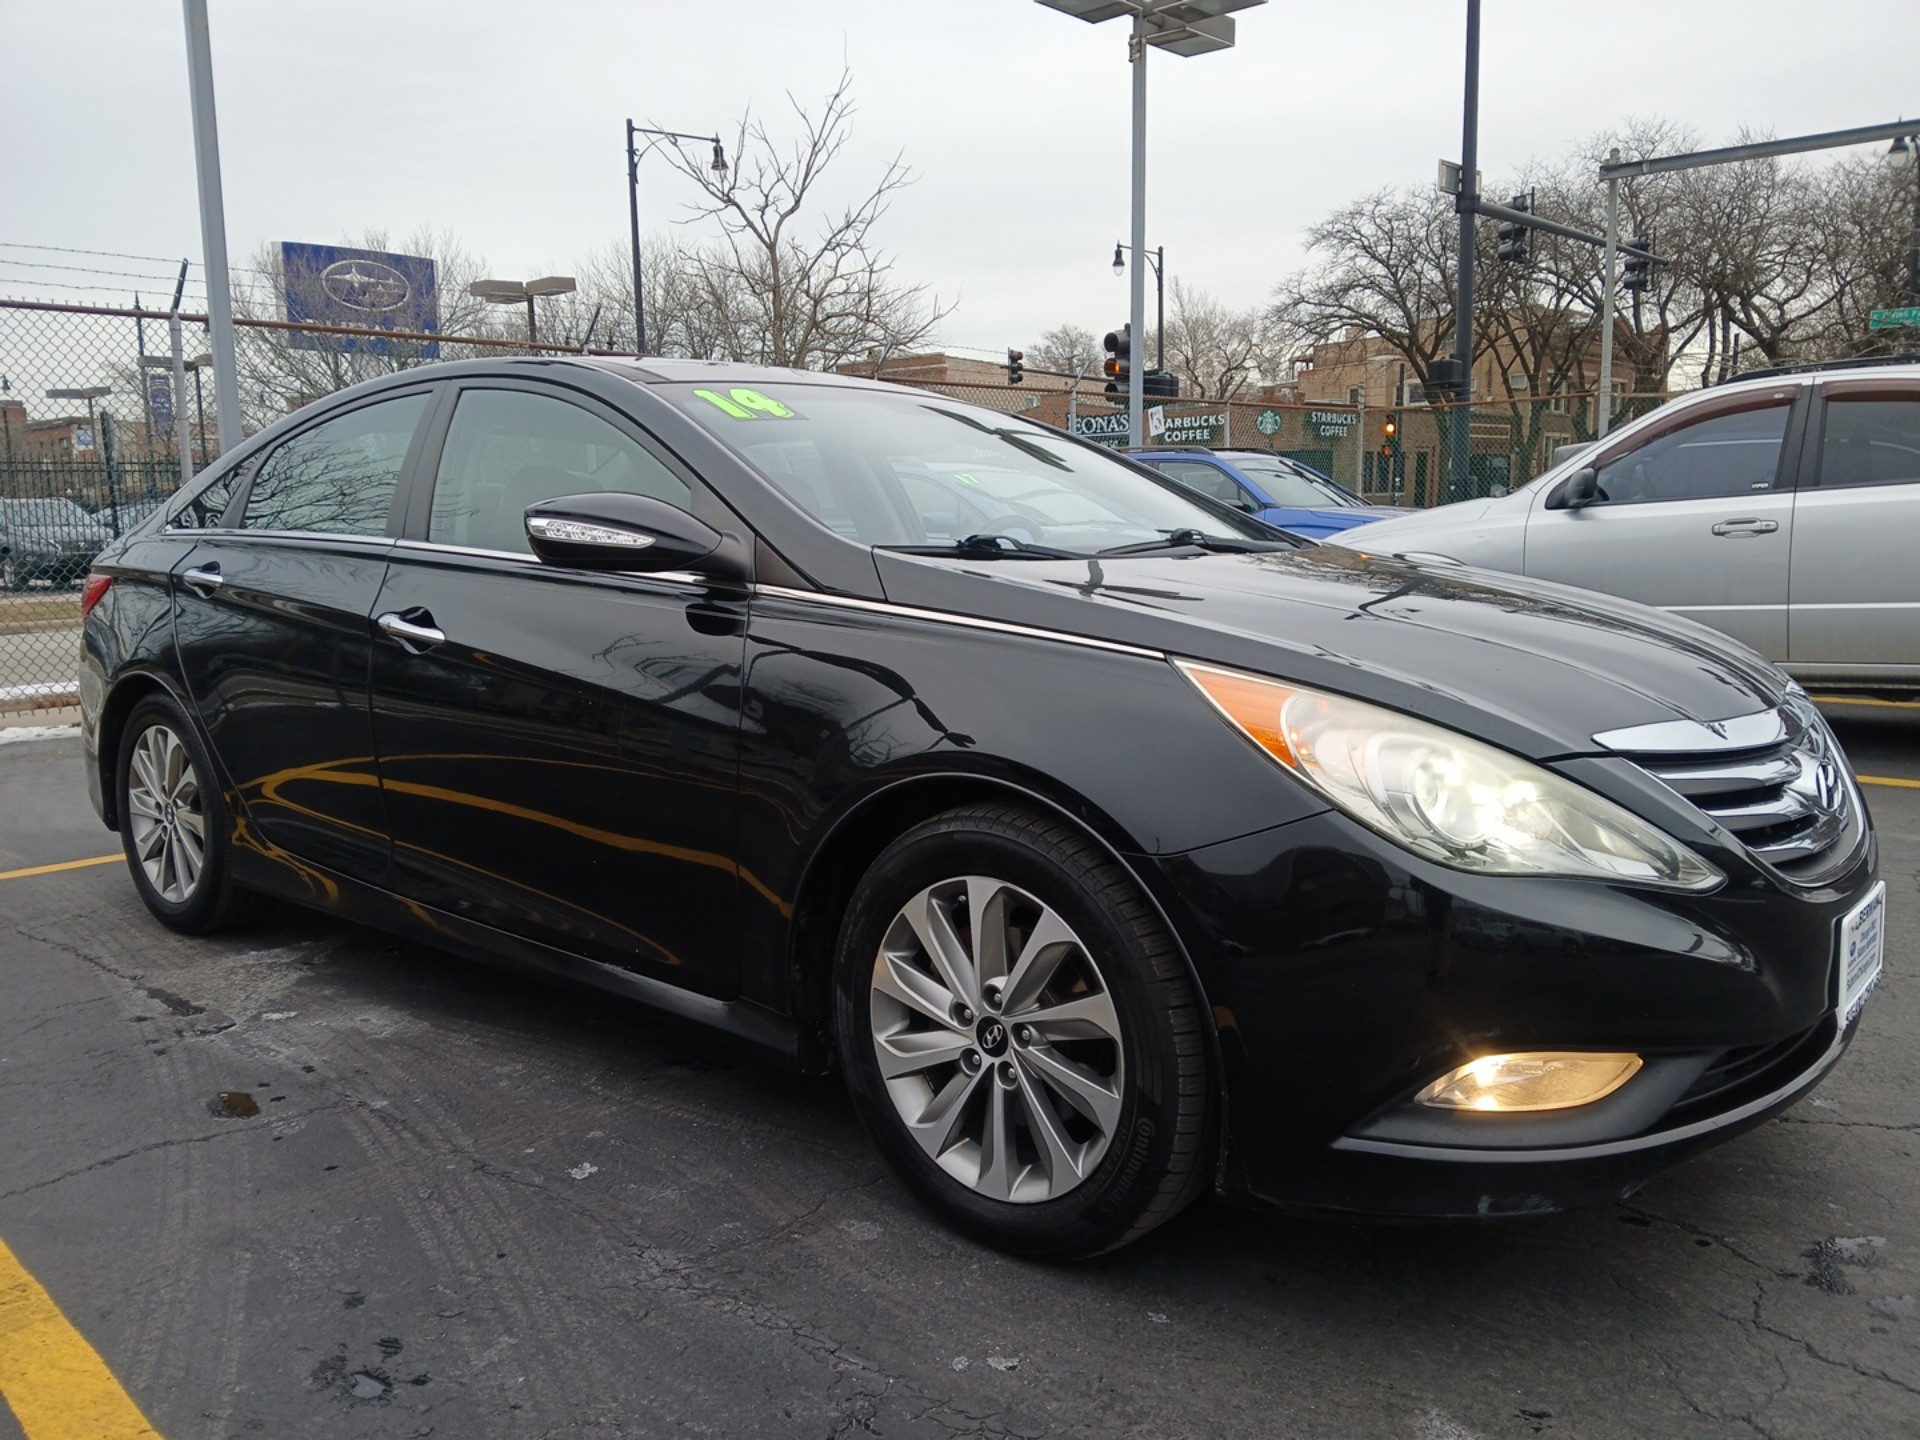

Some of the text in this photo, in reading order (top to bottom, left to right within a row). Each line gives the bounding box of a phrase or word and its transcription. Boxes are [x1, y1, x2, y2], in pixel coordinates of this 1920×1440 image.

[693, 388, 796, 419] 14
[1162, 414, 1225, 429] ARBUCKS
[1311, 411, 1357, 425] STARBUCKS
[1164, 428, 1211, 442] COFFEE
[1320, 424, 1348, 437] COFFEE
